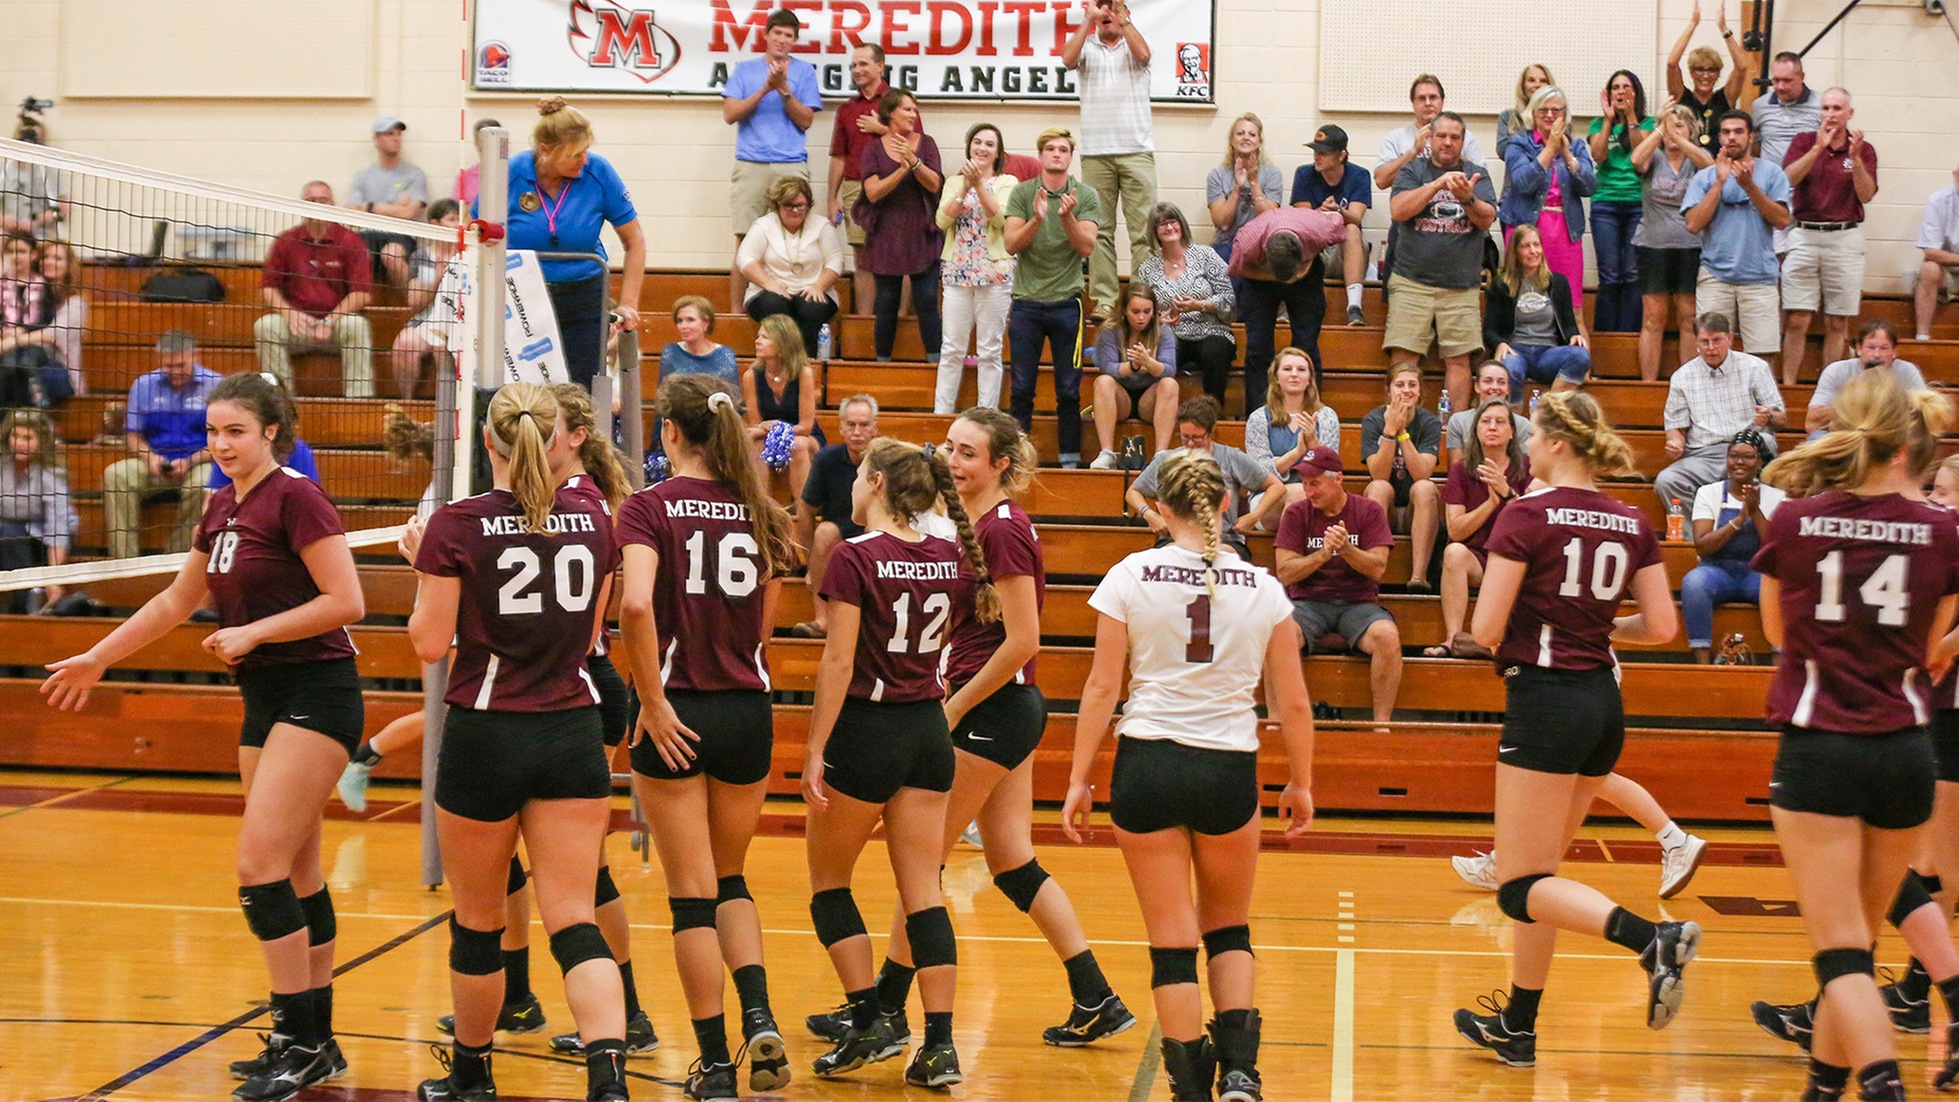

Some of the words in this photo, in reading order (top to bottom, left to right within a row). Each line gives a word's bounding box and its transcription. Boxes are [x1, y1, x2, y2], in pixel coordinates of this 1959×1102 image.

[1176, 86, 1208, 97] KFC
[505, 276, 533, 338] POWERADE
[480, 513, 596, 536] MERDITH
[664, 499, 754, 522] MEREDI
[1546, 508, 1639, 535] MEREDITH
[1798, 516, 1933, 545] MEREDITH
[206, 531, 240, 574] 18
[685, 530, 759, 597] 16
[876, 560, 959, 580] MEREDITH
[1559, 537, 1629, 601] 10
[496, 544, 595, 615] 20
[1814, 550, 1911, 627] 14
[887, 592, 950, 654] 12
[1185, 594, 1214, 663] 1
